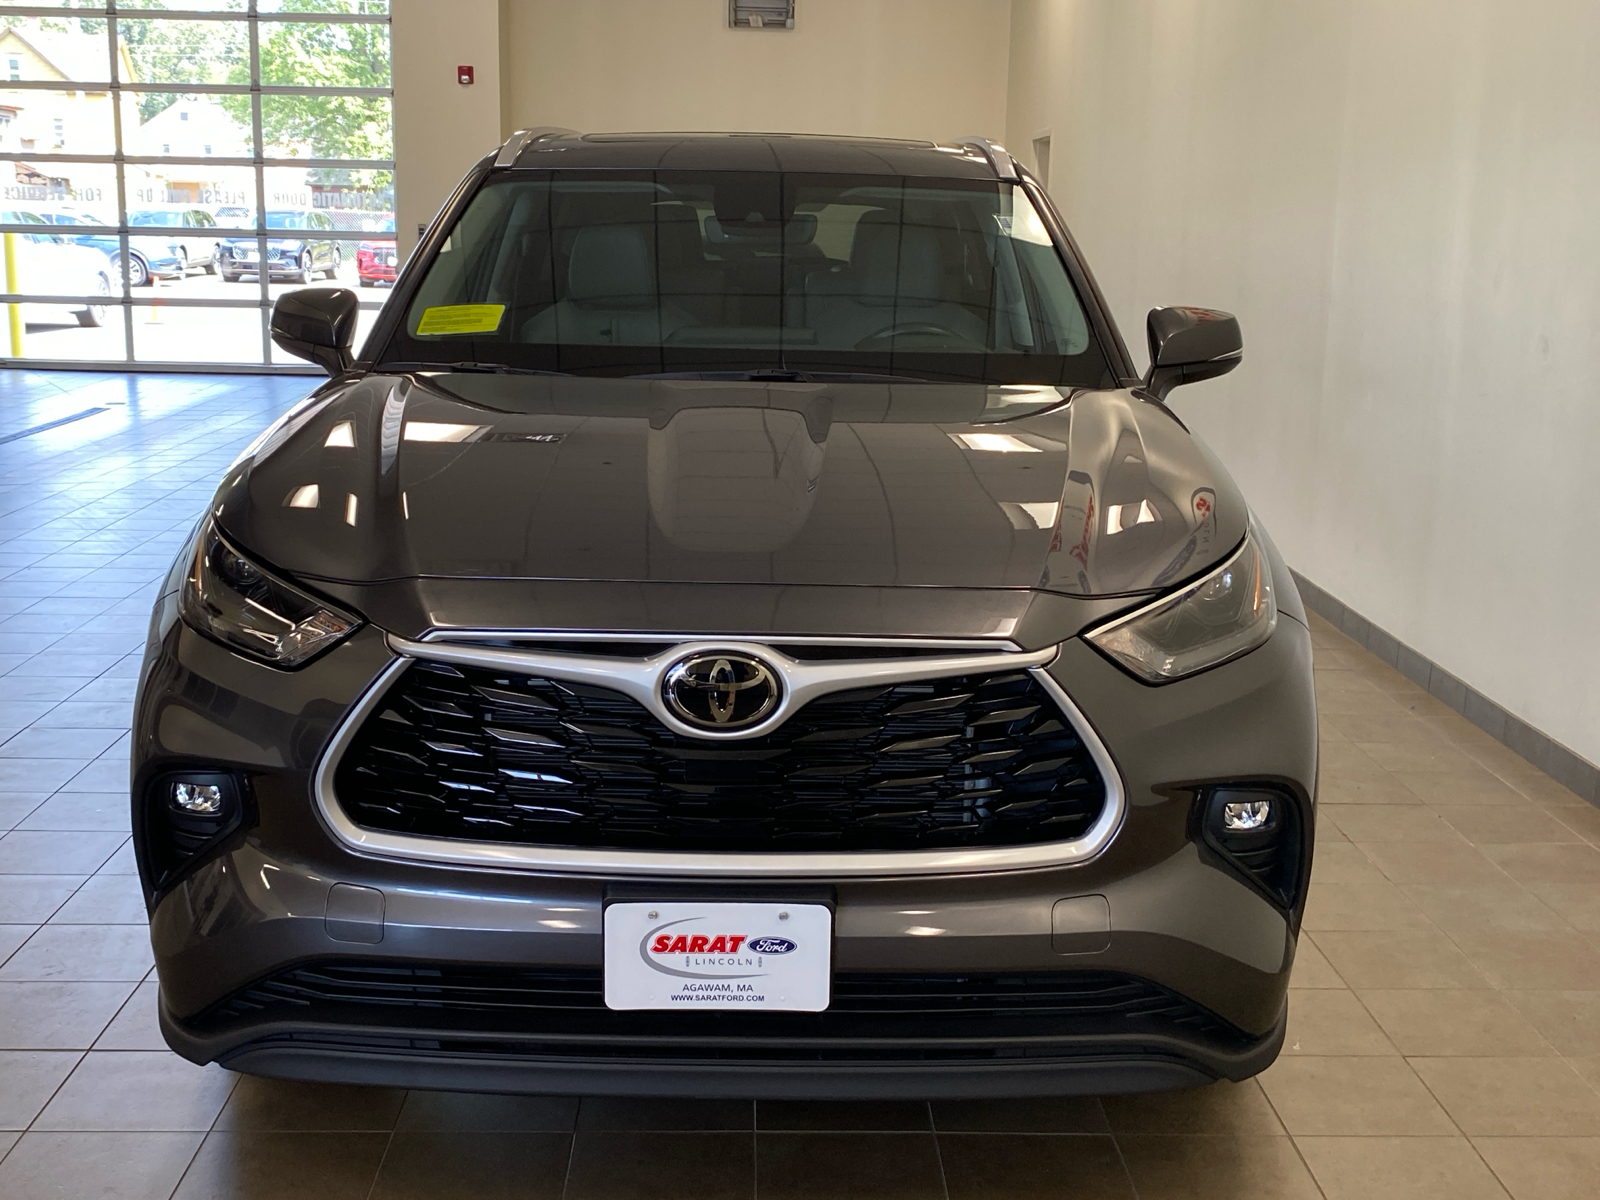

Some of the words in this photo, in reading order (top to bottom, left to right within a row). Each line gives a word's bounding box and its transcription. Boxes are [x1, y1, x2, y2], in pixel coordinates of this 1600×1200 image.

[650, 934, 748, 955] SARAT
[756, 939, 788, 953] Ford
[695, 958, 753, 966] LINCOLN
[682, 983, 734, 993] AGAWAM,
[737, 984, 754, 992] MA
[670, 994, 765, 1002] WWW.SARATFORD.COM
